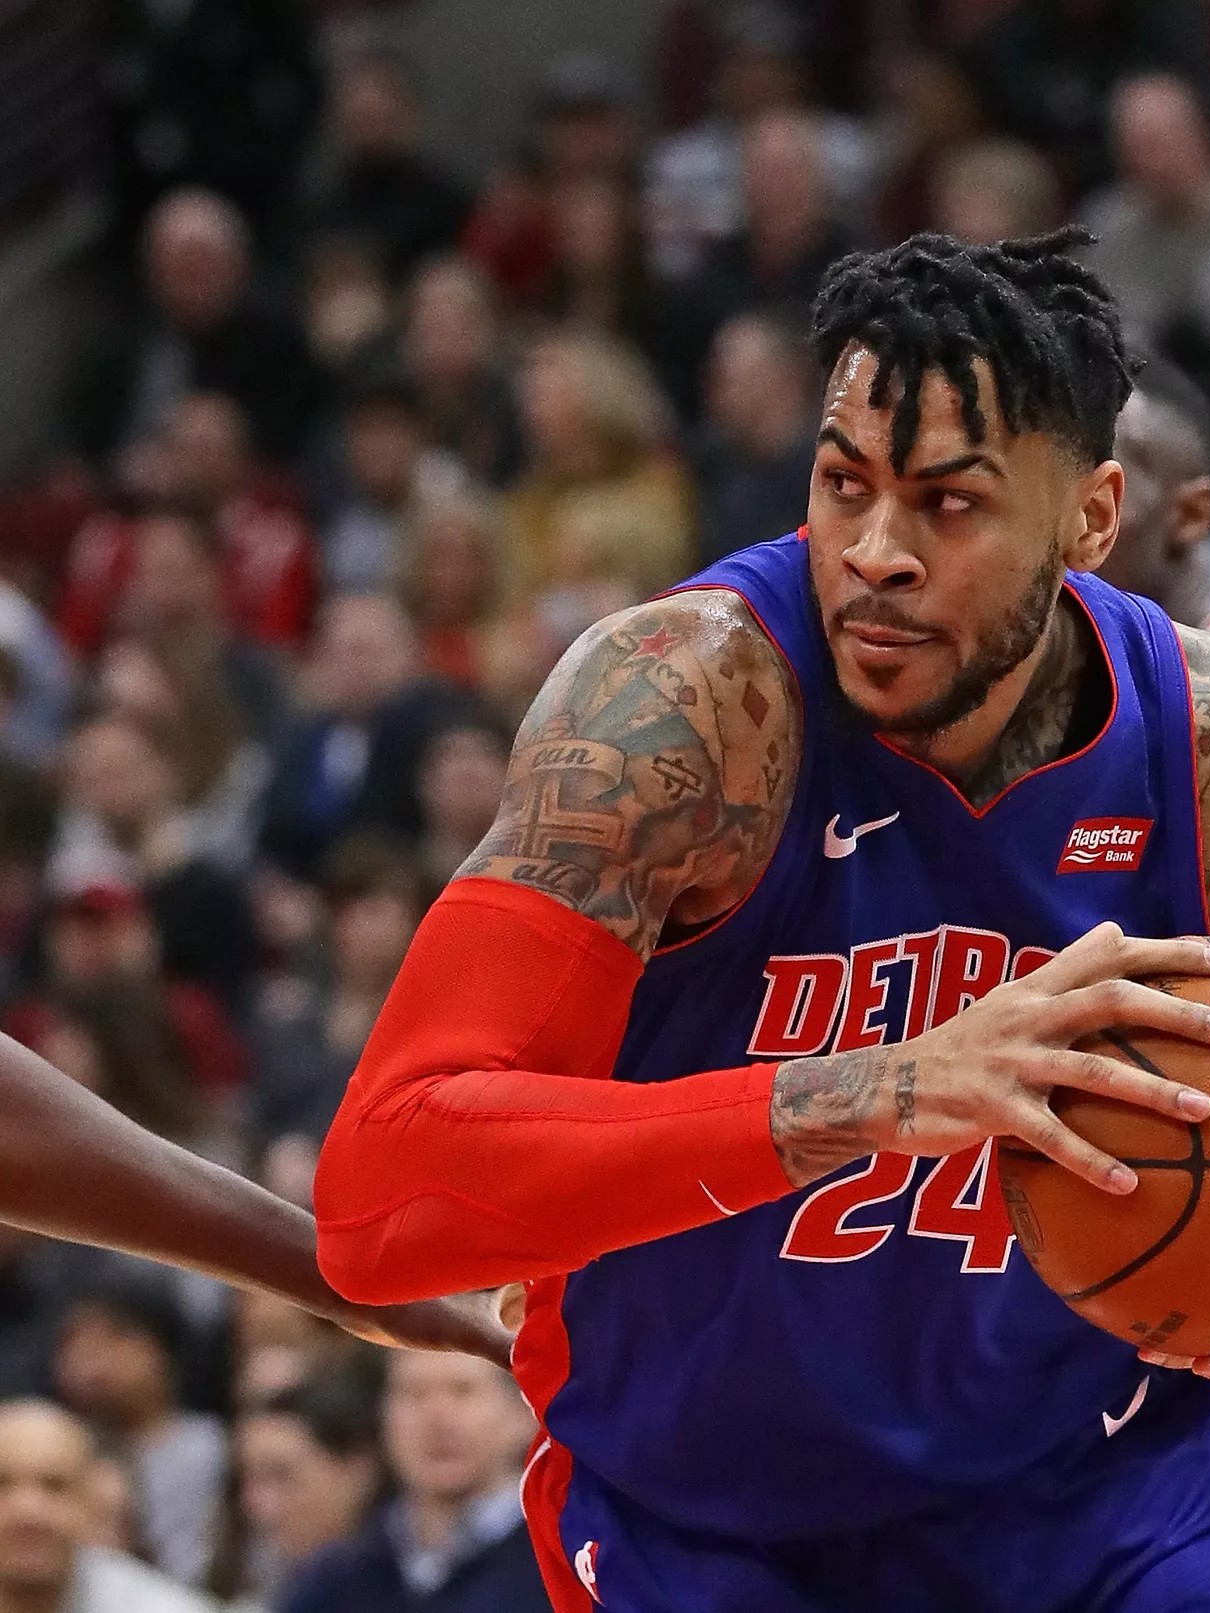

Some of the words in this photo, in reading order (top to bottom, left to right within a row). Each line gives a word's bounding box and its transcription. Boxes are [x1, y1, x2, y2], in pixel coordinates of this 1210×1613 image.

[1067, 825, 1143, 849] Flagstar
[1105, 850, 1135, 862] Bank
[746, 923, 1060, 1056] DETR
[779, 1135, 1018, 1274] 24
